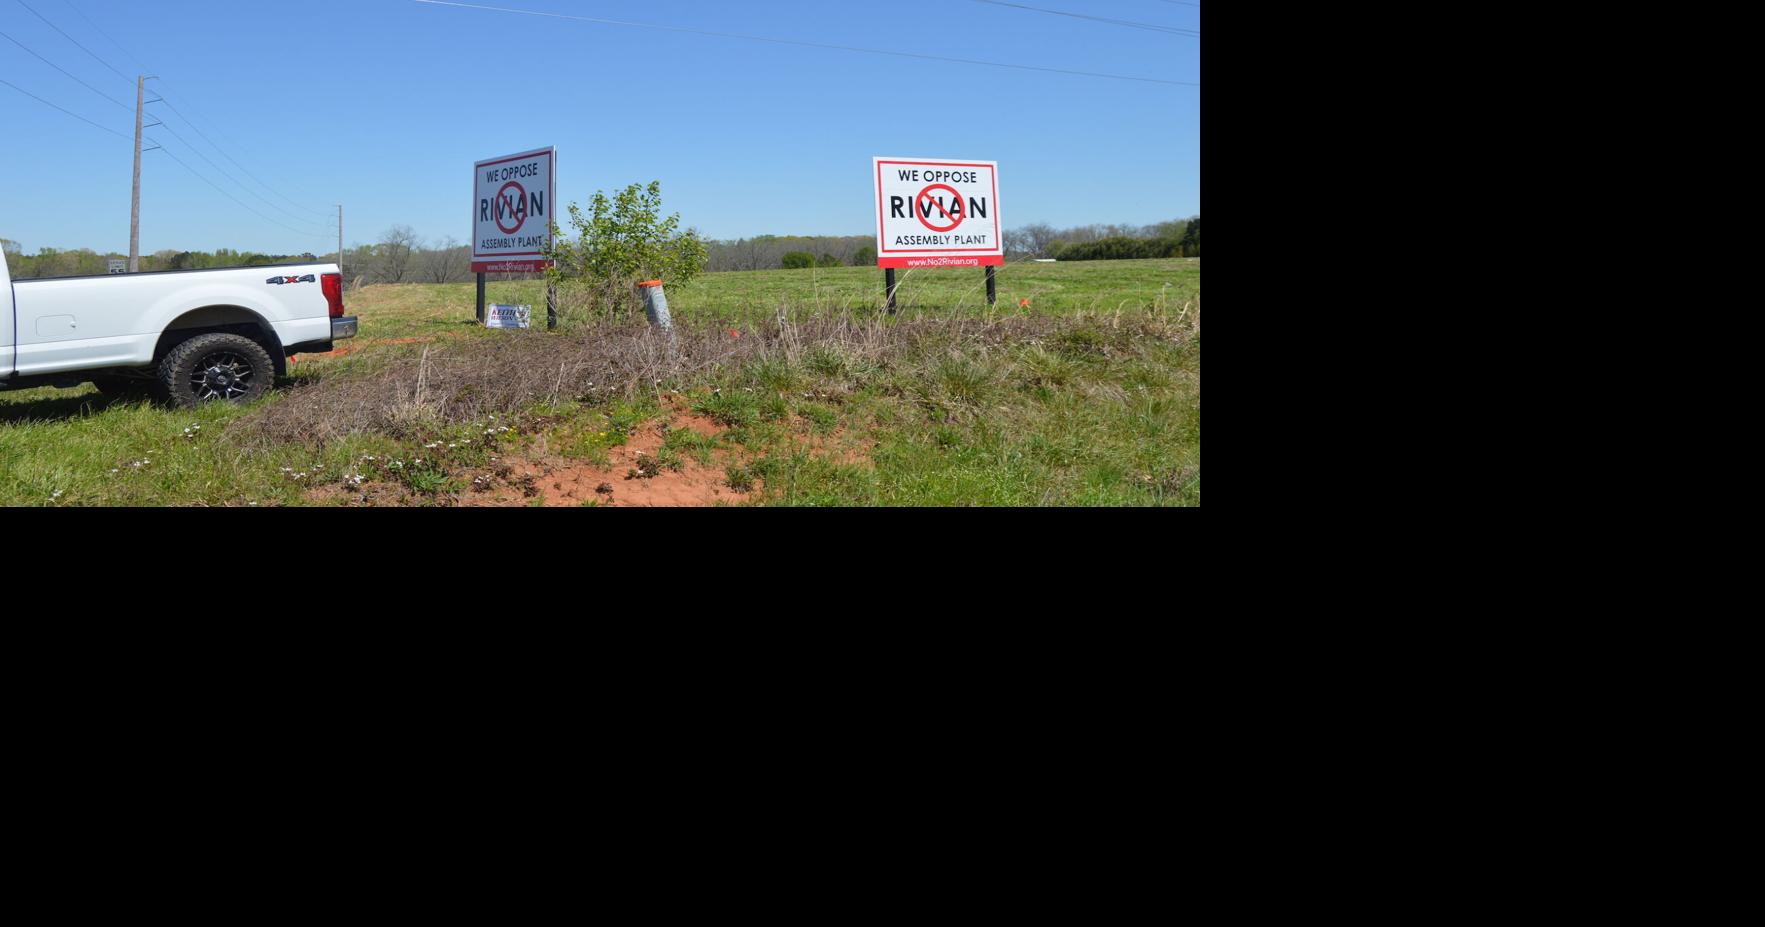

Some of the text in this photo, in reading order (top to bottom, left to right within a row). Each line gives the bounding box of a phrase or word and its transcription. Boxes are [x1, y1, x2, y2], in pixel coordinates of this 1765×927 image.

[486, 163, 538, 183] WE OPPOSE
[898, 169, 977, 183] WE OPPOSE
[480, 190, 544, 223] RIVIAN
[890, 195, 988, 219] RIVIAN
[481, 235, 543, 250] ASSEMBLY PLANT
[895, 235, 987, 245] ASSEMBLY PLANT
[907, 258, 979, 266] www.No2Rivian.org
